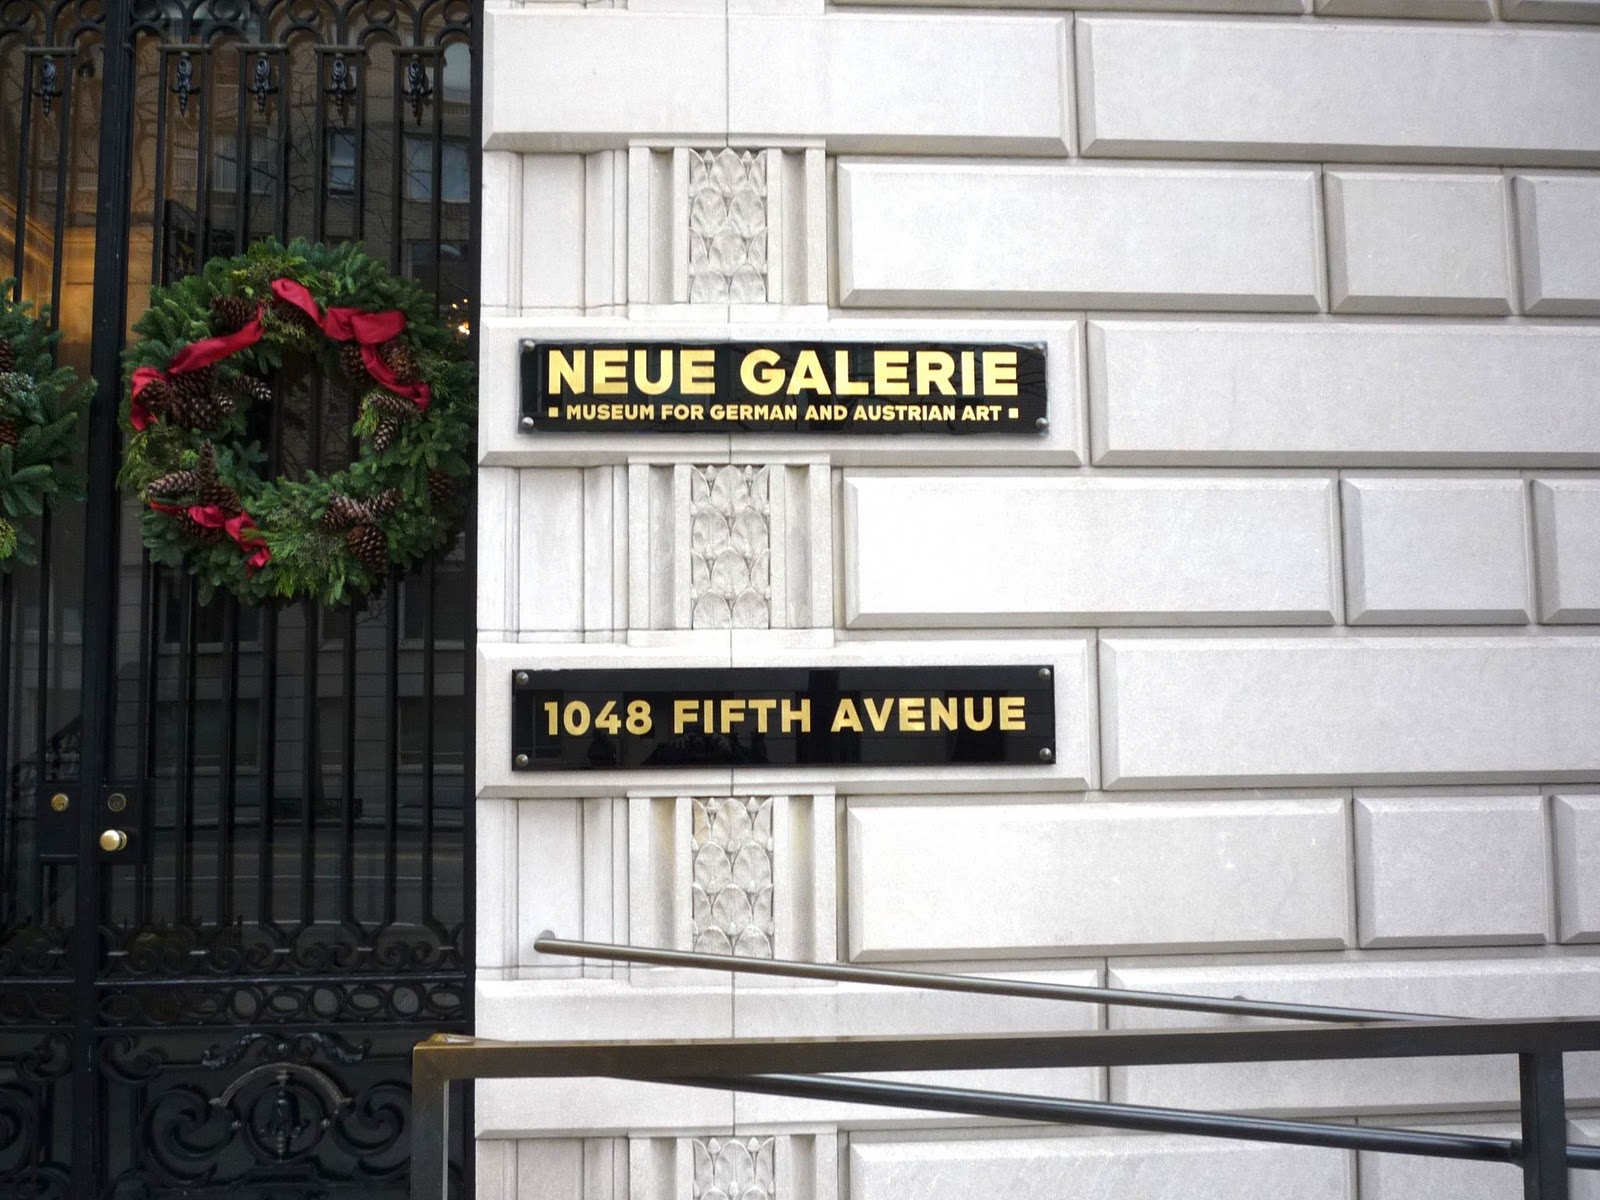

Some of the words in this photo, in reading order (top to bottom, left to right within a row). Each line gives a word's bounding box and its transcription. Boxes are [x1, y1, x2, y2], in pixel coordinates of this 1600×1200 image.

[549, 350, 715, 395] NEUE
[740, 349, 1018, 396] GALERIE
[567, 404, 654, 420] MUSEUM
[661, 404, 704, 420] FOR
[710, 404, 797, 420] GERMAN
[805, 405, 847, 420] AND
[854, 405, 955, 421] AUSTRIAN
[962, 405, 1002, 421] ART
[545, 700, 652, 735] 1048
[674, 699, 810, 733] FIFTH
[831, 697, 1025, 732] AVENUE
